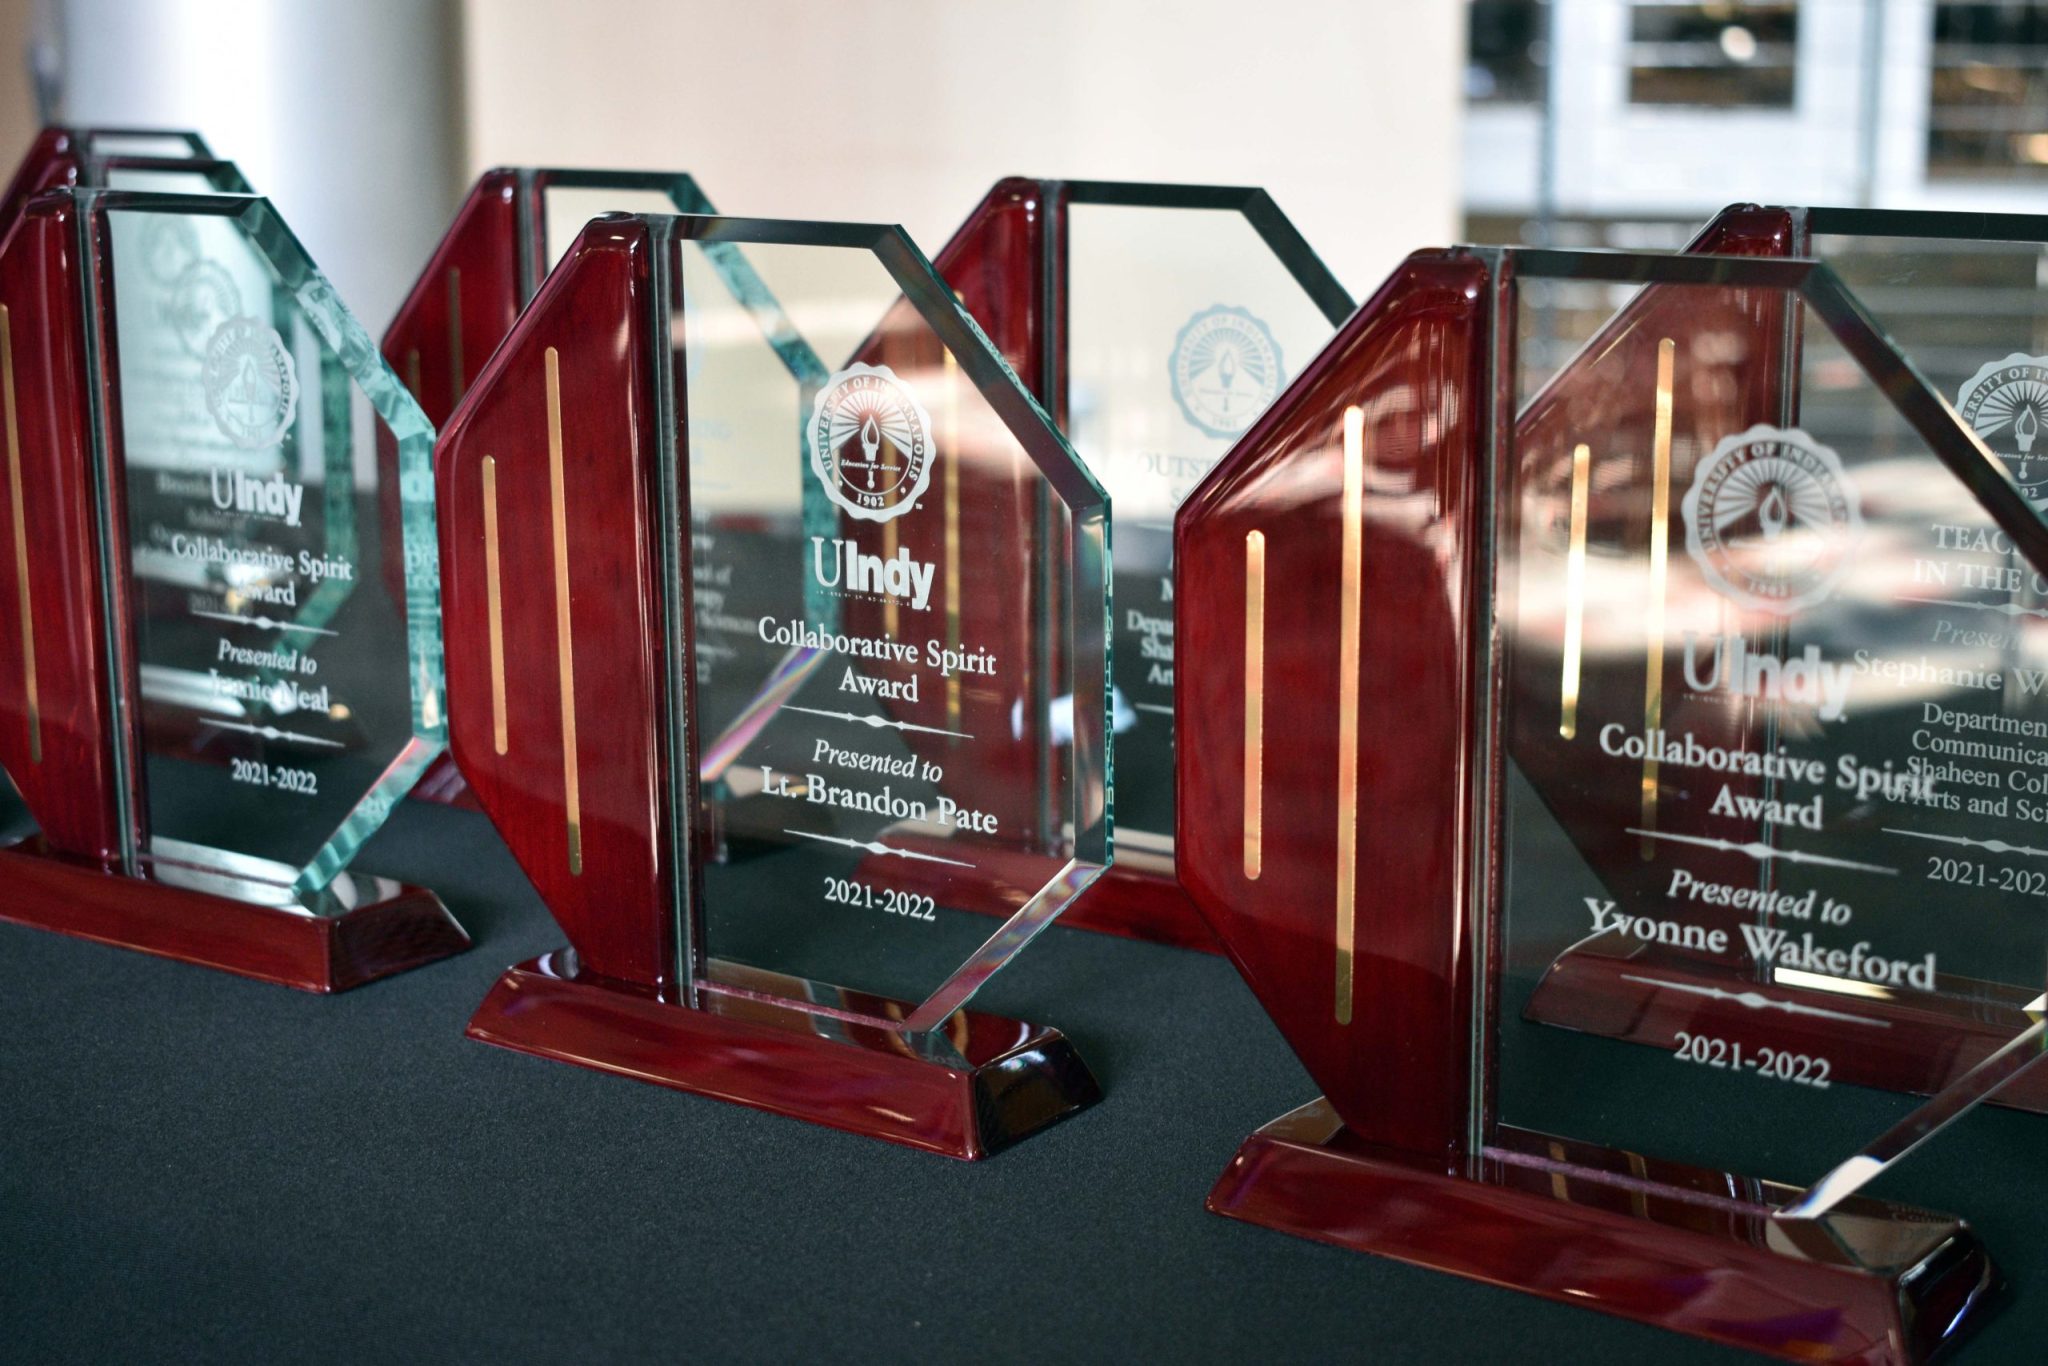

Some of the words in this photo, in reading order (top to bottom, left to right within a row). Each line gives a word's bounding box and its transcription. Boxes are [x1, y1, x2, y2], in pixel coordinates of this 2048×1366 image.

[2008, 367, 2030, 380] OF
[817, 381, 850, 471] UNIVERSITY
[853, 376, 870, 390] OF
[210, 467, 303, 527] UIndy
[856, 493, 885, 507] 1902
[171, 532, 294, 573] Collaborative
[299, 549, 353, 582] Spirit
[1931, 523, 2021, 556] TEAC
[811, 536, 936, 610] UIndy
[1912, 558, 1949, 585] IN
[1957, 563, 2022, 592] THE
[217, 637, 298, 672] Presented
[300, 654, 317, 675] to
[758, 616, 919, 664] Collaborative
[926, 639, 997, 677] Spirit
[838, 665, 919, 703] Award
[1682, 630, 1850, 722] UIndy
[1853, 650, 2003, 691] Stephanie
[1921, 701, 2048, 739] Departmen
[812, 738, 918, 778] Presented
[921, 759, 943, 783] to
[1599, 722, 1826, 784] Collaborative
[1835, 753, 1934, 801] Spirit
[1911, 728, 2048, 767] Communica
[231, 757, 318, 796] 2021-2022
[1906, 754, 2001, 789] Shaheen
[760, 765, 798, 799] Lt.
[806, 773, 927, 822] Brandon
[936, 795, 999, 834] Pate
[1708, 783, 1824, 831] Award
[1967, 796, 2009, 818] and
[824, 876, 936, 922] 2021-2022
[1666, 868, 1817, 920] Presented
[1820, 897, 1852, 926] to
[1926, 856, 2048, 897] 2021-202
[1583, 896, 1729, 953] Yvonne
[1739, 922, 1936, 993] Wakeford
[1672, 1030, 1832, 1090] 2021-2022
